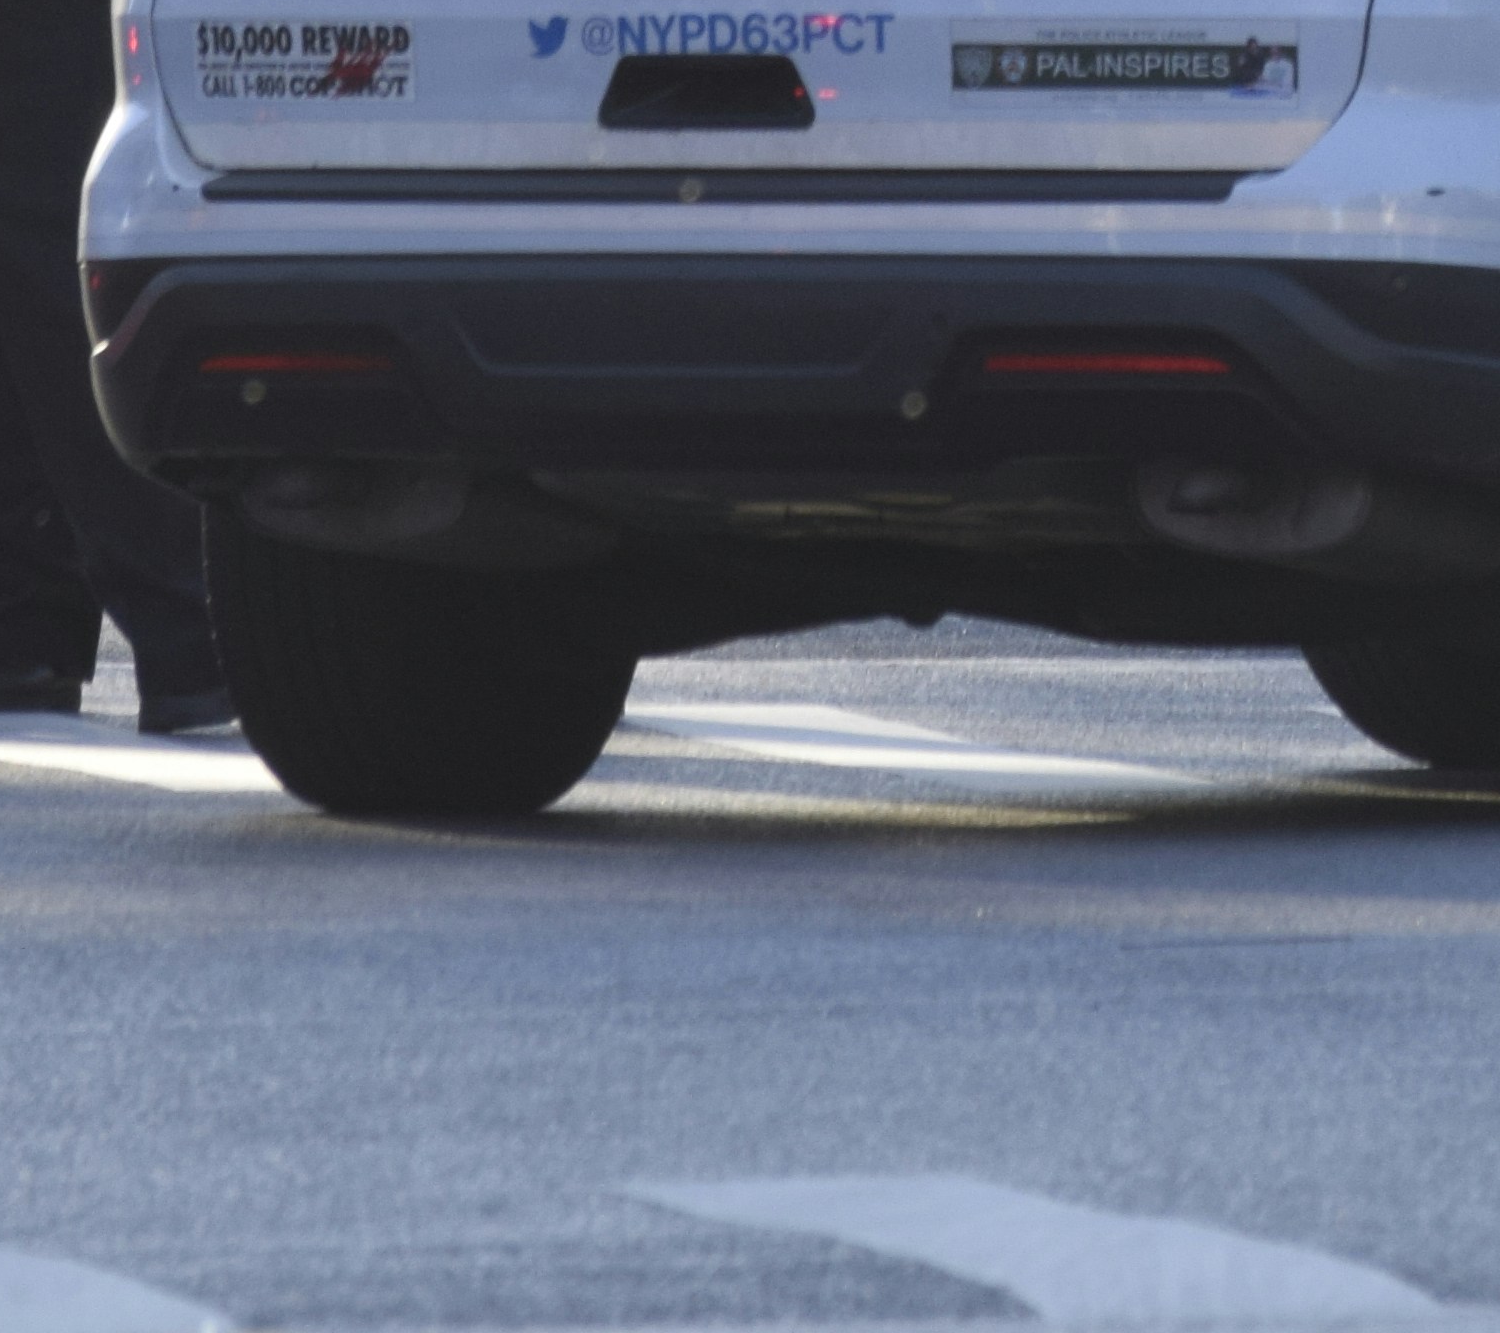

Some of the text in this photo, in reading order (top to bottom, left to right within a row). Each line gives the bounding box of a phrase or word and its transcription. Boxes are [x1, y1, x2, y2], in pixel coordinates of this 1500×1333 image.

[197, 21, 411, 63] $10,000 REWARD
[581, 12, 895, 55] @NYPD63PCT
[1035, 52, 1231, 79] PAL INSPIRES
[202, 74, 237, 98] CALL
